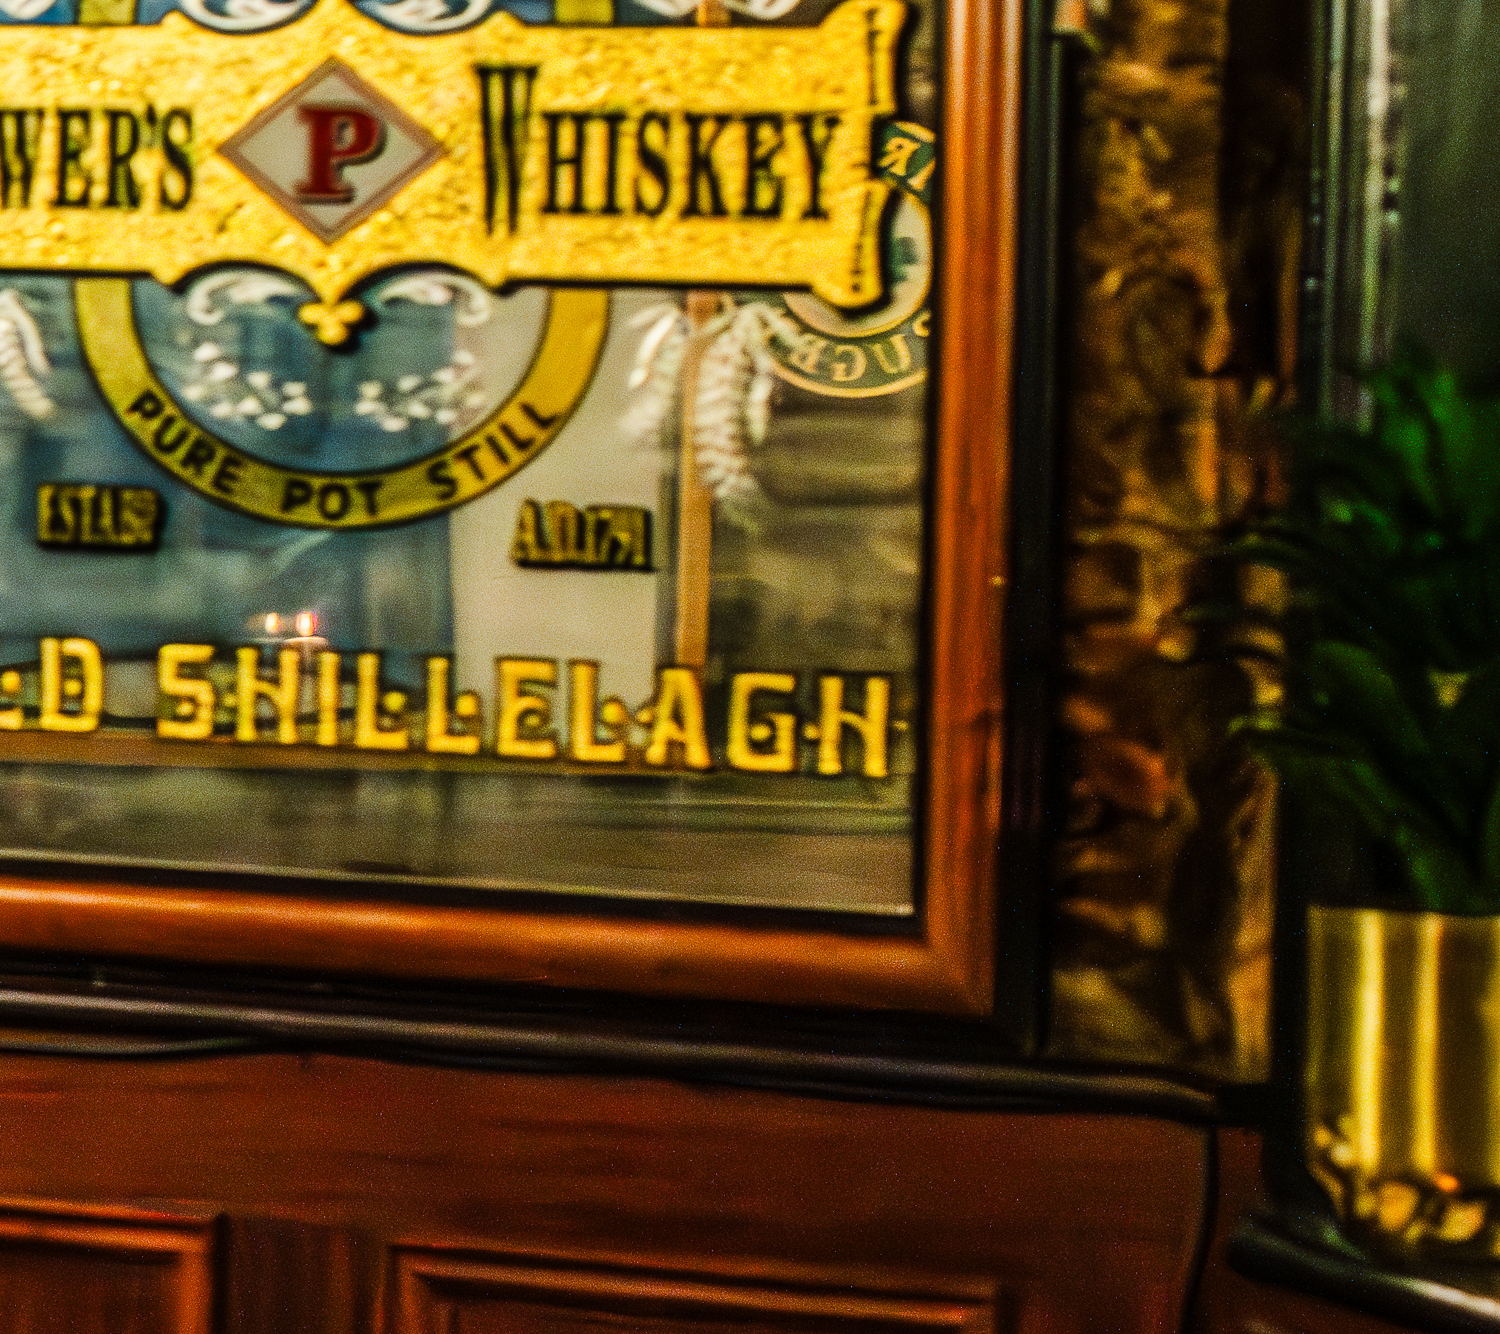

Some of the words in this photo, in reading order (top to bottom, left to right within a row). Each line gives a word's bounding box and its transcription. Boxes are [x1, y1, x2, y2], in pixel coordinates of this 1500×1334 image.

[292, 102, 388, 207] P
[474, 63, 842, 239] WHISKEY
[128, 389, 246, 495] PURE
[281, 478, 383, 522] POT
[425, 402, 561, 500] STILL
[155, 641, 902, 779] SHILLELAGH
